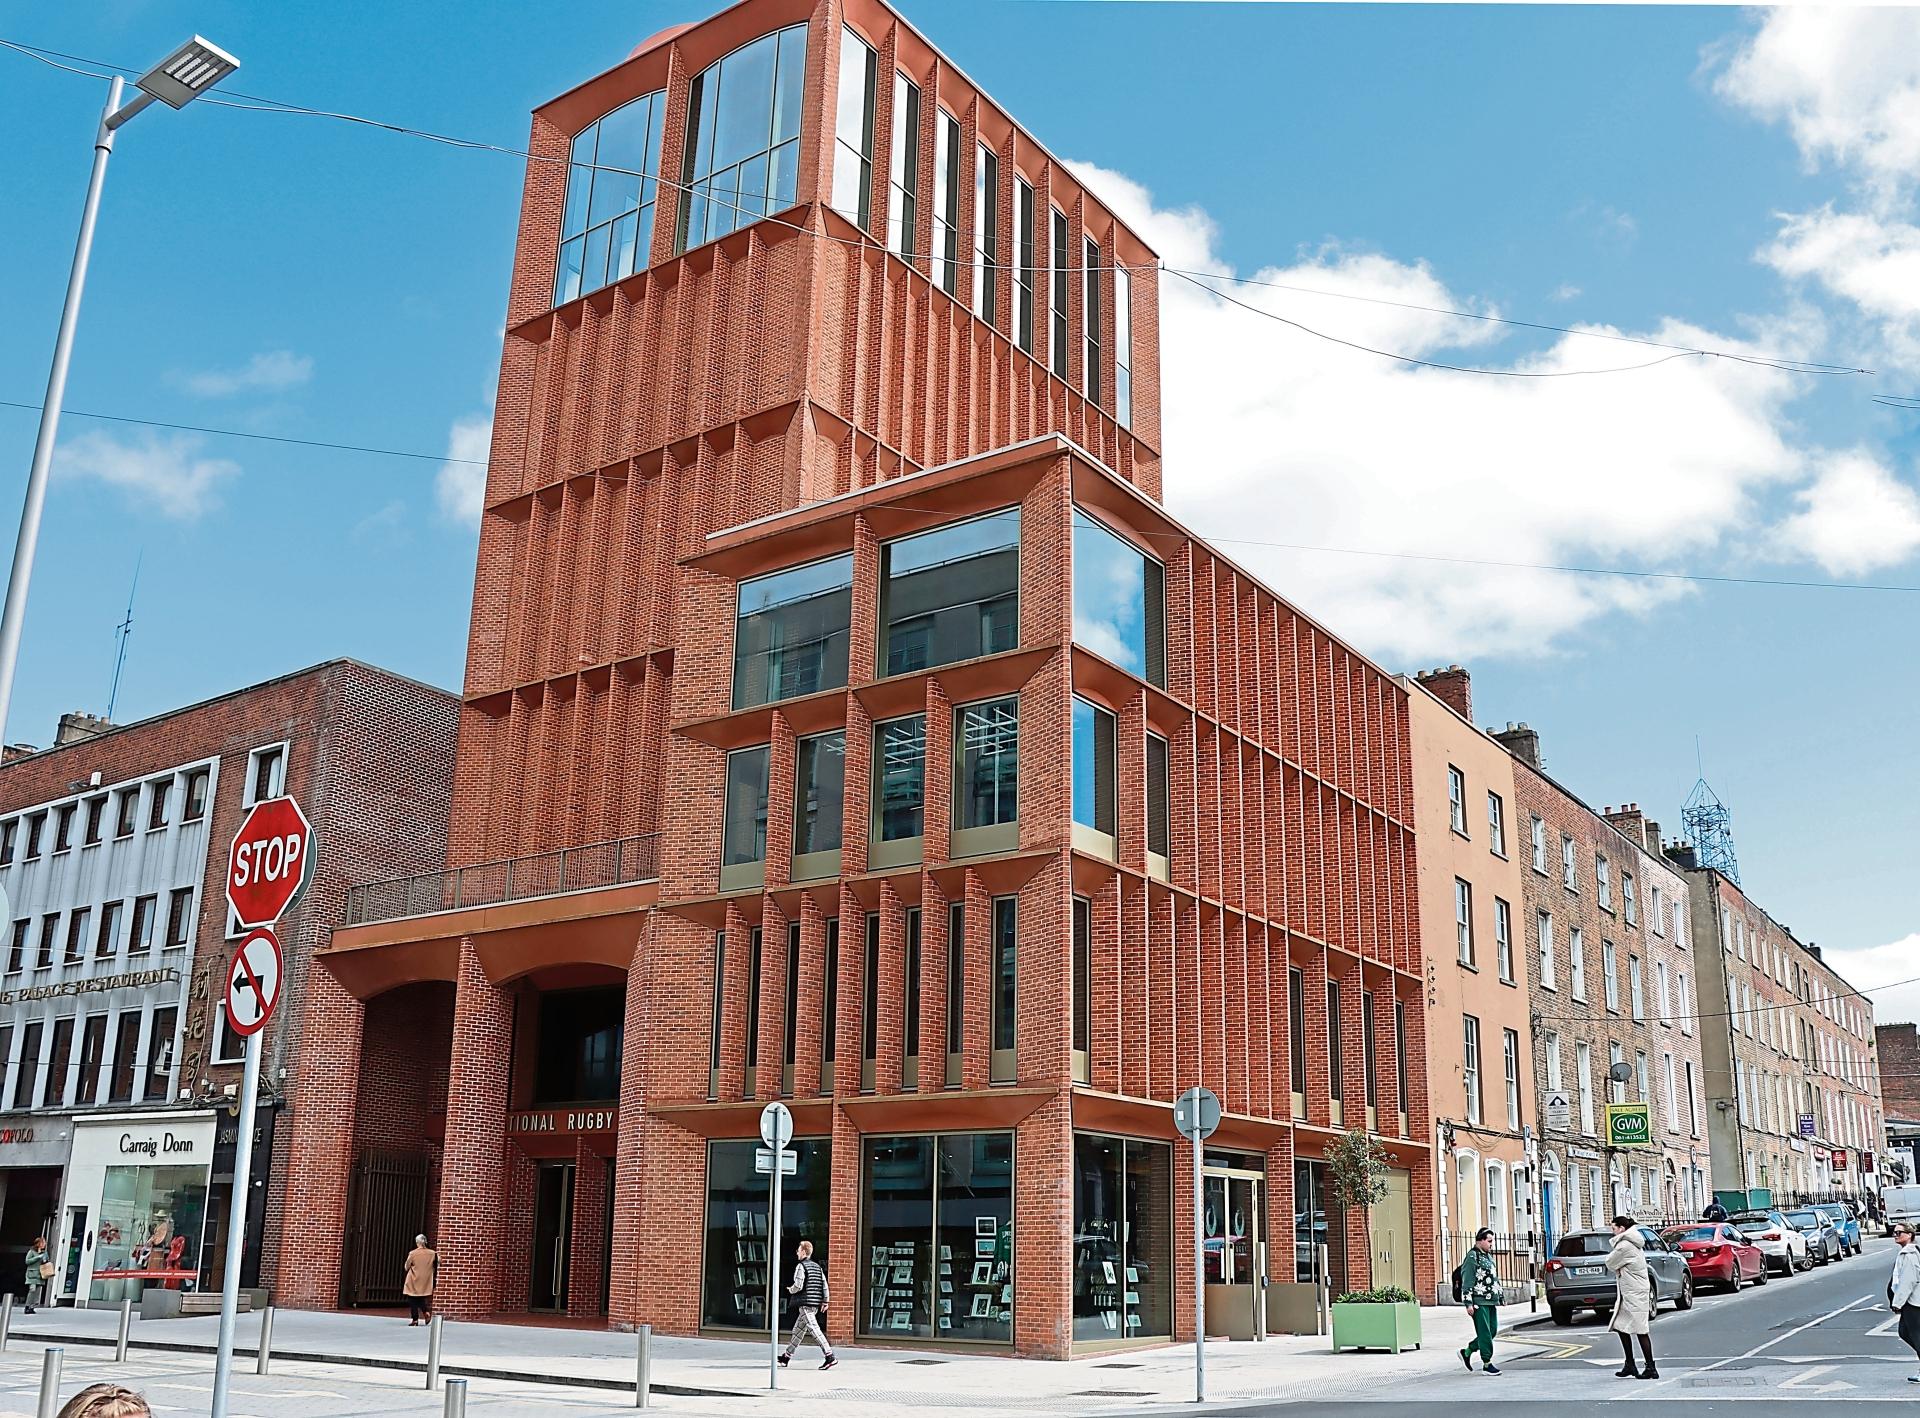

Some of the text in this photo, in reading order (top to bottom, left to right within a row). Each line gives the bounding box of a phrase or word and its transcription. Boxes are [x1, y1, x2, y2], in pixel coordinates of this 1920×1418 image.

[234, 833, 301, 887] STOP
[19, 984, 70, 1001] PALACE
[75, 967, 174, 995] RESTAURANT
[567, 1112, 613, 1130] RUGBY
[1616, 1118, 1642, 1130] GVM
[119, 1132, 194, 1157] Carraig Donn
